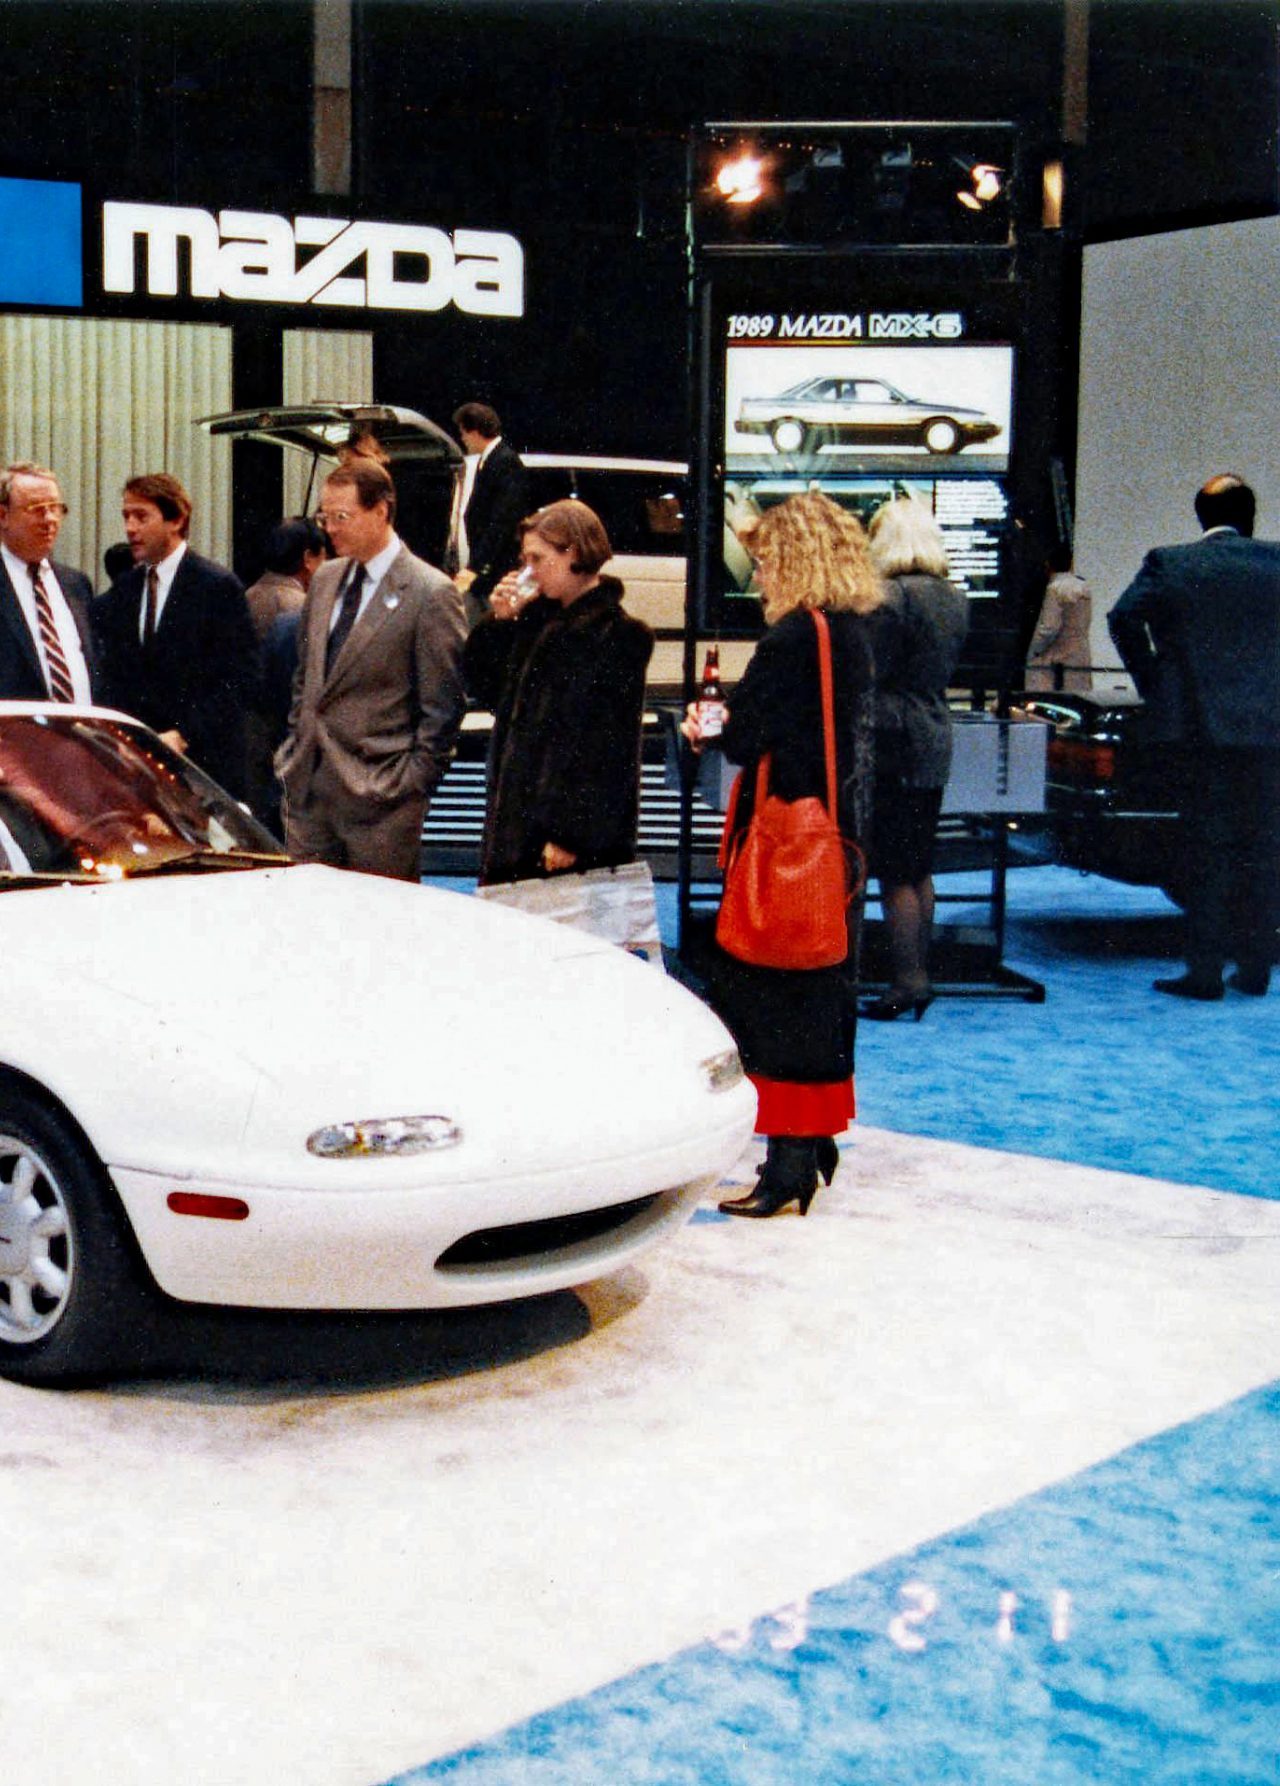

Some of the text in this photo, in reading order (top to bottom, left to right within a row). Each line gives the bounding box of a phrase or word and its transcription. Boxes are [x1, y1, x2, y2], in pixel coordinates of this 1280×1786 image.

[103, 201, 524, 317] mazda
[727, 313, 962, 338] 1989 MAZDA MX-6
